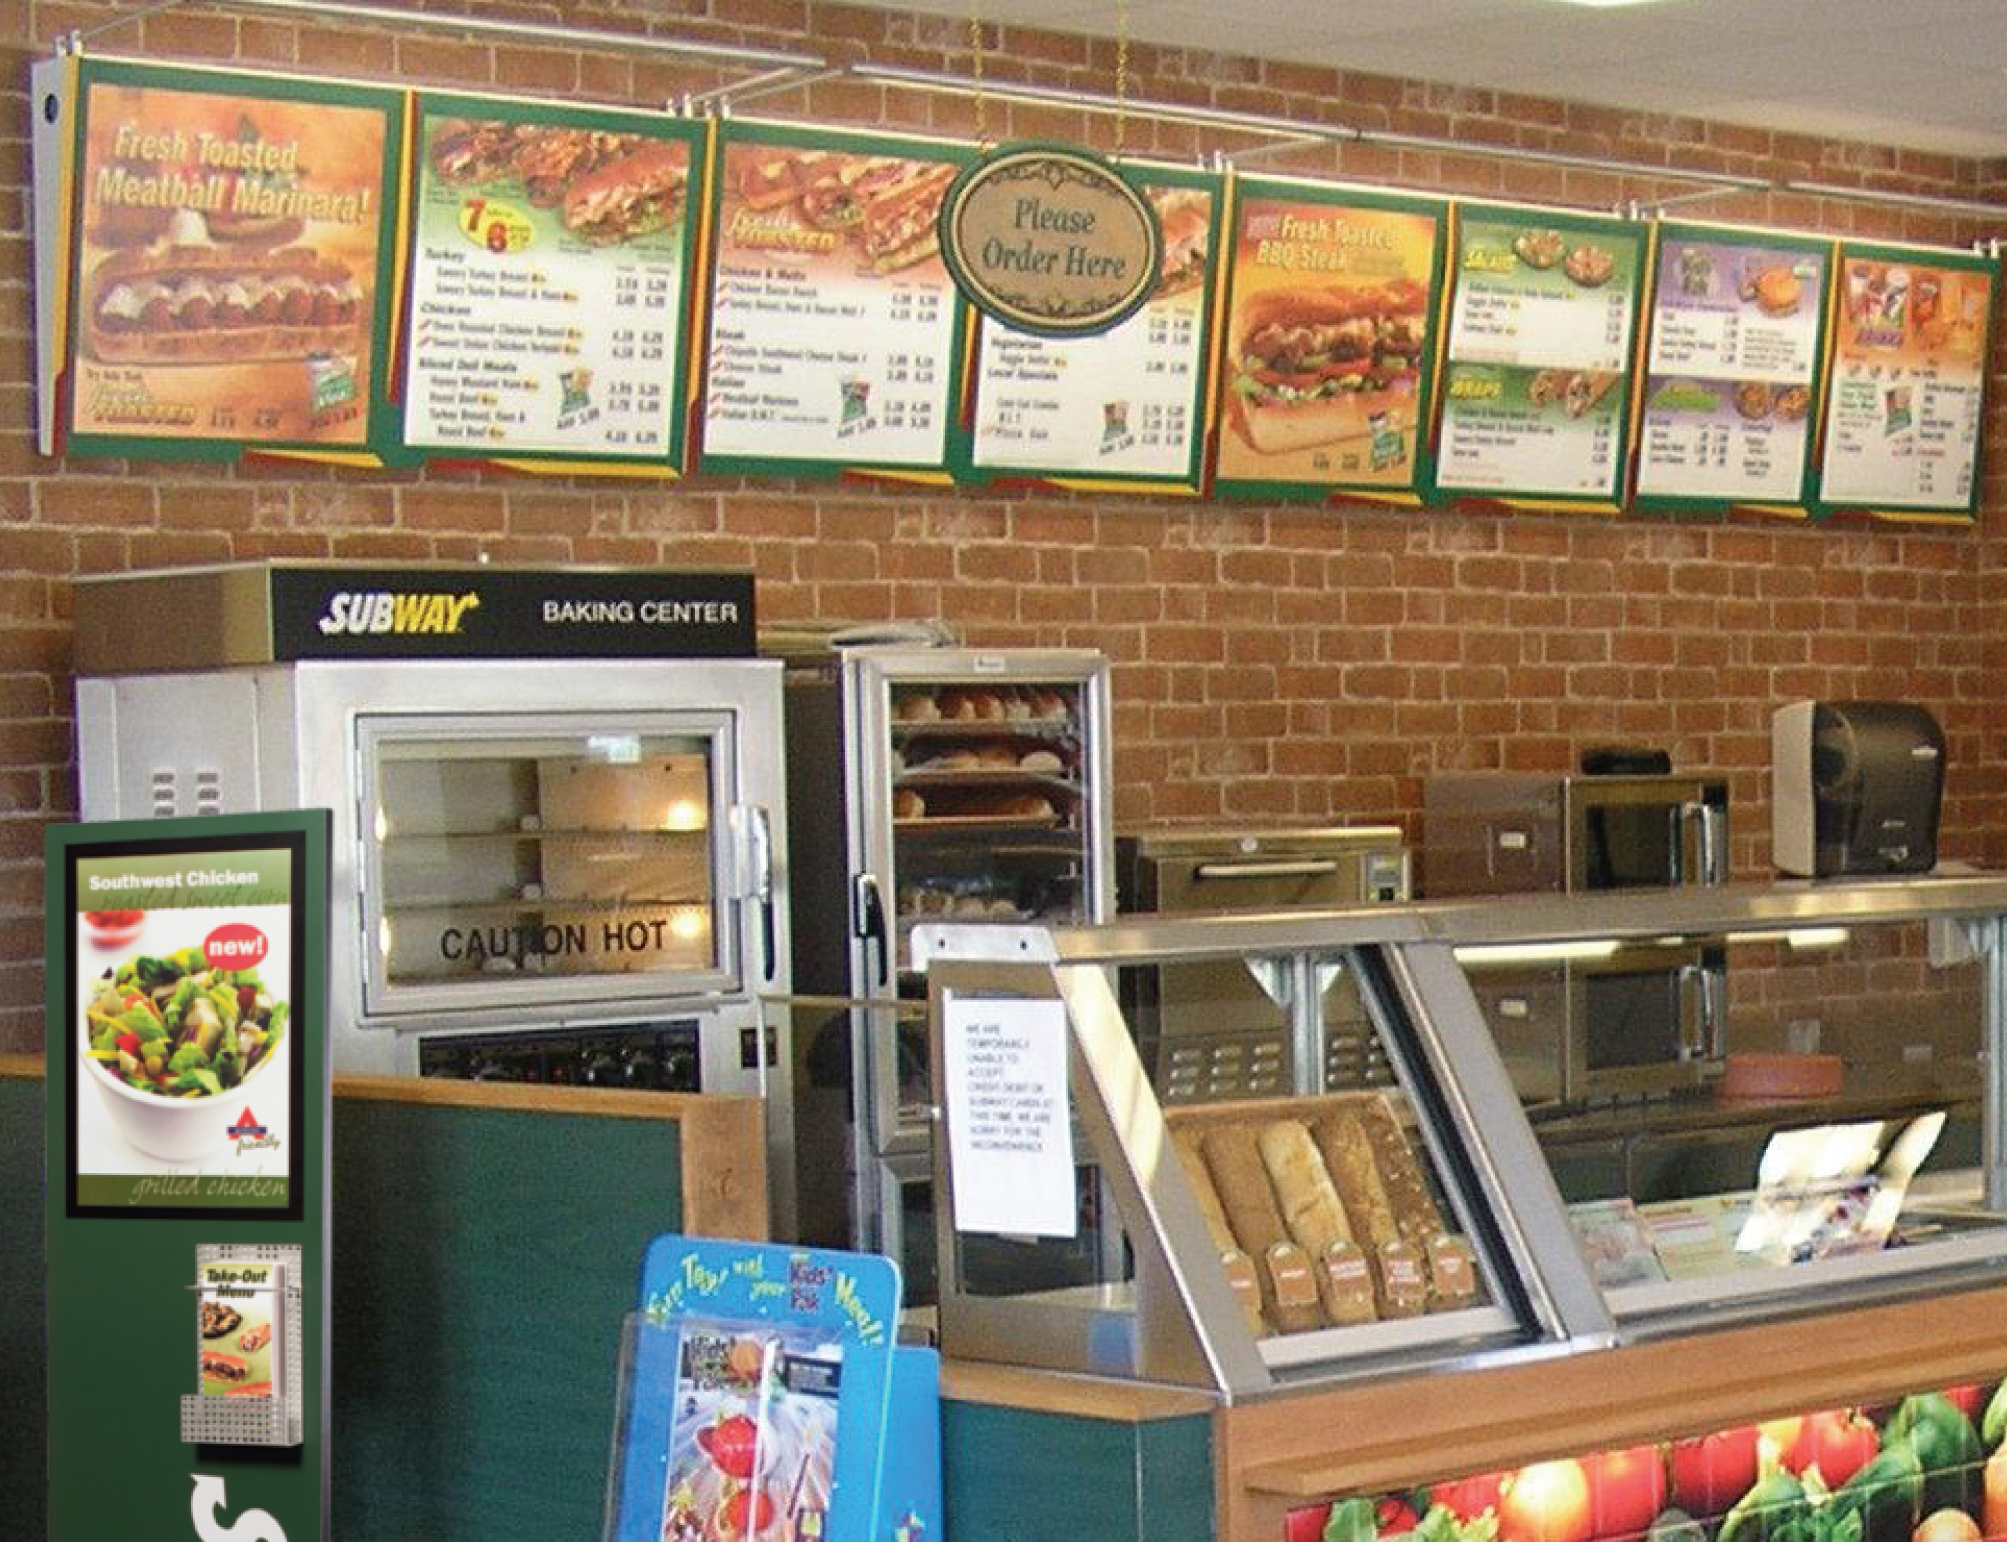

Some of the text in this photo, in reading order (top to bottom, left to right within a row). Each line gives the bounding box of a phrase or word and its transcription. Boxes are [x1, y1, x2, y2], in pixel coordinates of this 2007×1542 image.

[114, 122, 299, 171] Fresh Toasted
[95, 167, 371, 225] Meatball Marinara!
[464, 199, 487, 233] 7
[1014, 197, 1096, 234] Please
[1281, 213, 1328, 241] Fresh
[486, 223, 508, 254] 6
[425, 248, 465, 263] Turkey
[982, 236, 1127, 280] Order Here
[1256, 238, 1295, 270] BBQ
[1300, 243, 1349, 273] Steak
[420, 302, 471, 316] Chicken
[319, 591, 480, 635] SUBWAY
[542, 600, 738, 624] BAKING CENTER
[88, 868, 259, 891] Southwest Chicken
[208, 935, 264, 956] new!
[441, 919, 667, 960] CAUTON HOT
[128, 1164, 286, 1205] grilled chicken
[207, 1268, 268, 1284] Take-Out
[216, 1284, 255, 1298] Menu
